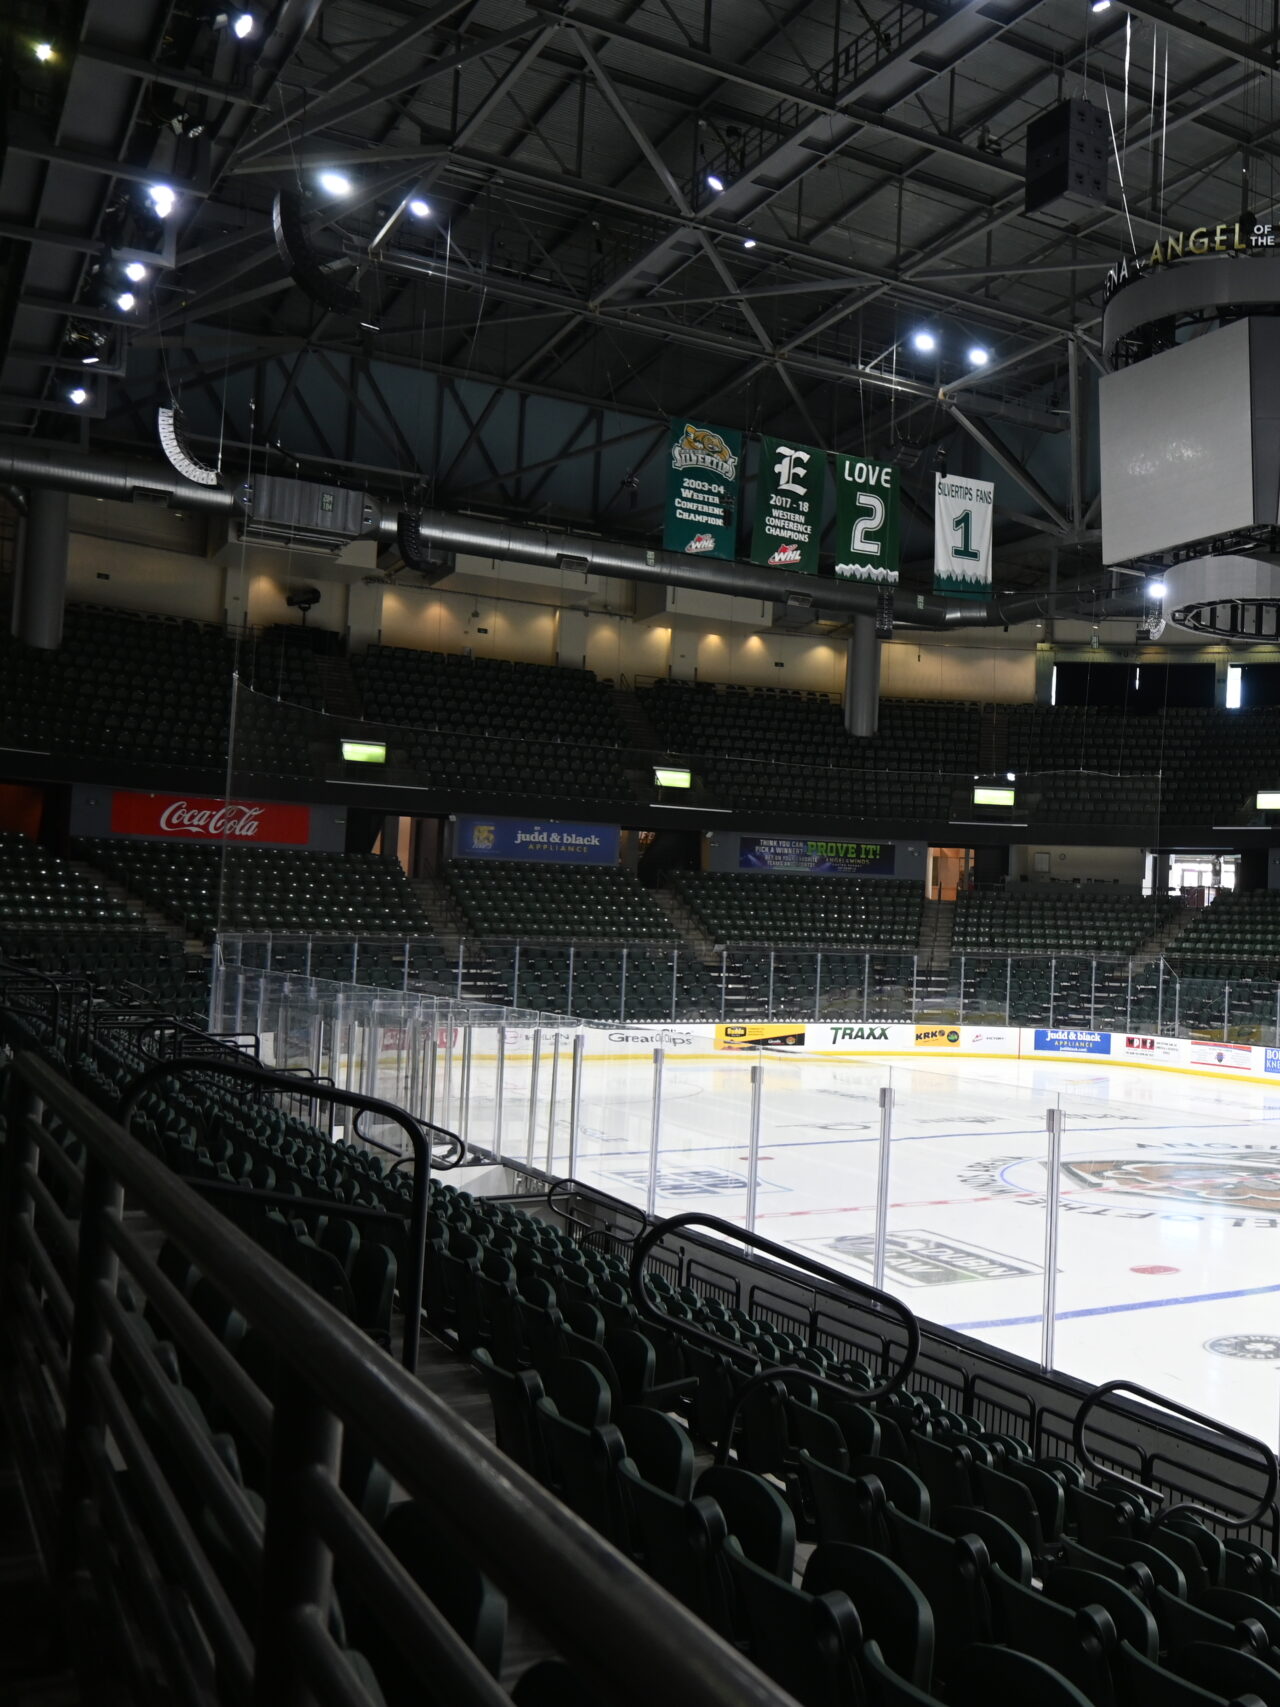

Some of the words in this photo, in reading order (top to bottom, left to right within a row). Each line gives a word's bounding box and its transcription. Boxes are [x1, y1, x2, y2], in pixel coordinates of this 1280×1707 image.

[1253, 224, 1272, 235] OF
[1150, 223, 1246, 267] ANGEL
[1250, 236, 1275, 246] THE
[673, 446, 737, 478] SILVERTIPS
[774, 446, 811, 496] E
[844, 461, 892, 488] LOVE
[683, 478, 725, 494] 2003-04
[937, 482, 973, 501] SILVERTIPS
[975, 489, 992, 505] FANS
[681, 488, 720, 504] WESTER
[770, 494, 792, 509] 2017
[799, 501, 809, 513] 18
[675, 498, 725, 516] CONFERENC
[772, 509, 805, 523] WESTERN
[676, 509, 725, 527] CHAMPION
[765, 517, 812, 534] CONFERENCE
[850, 492, 885, 556] 2
[765, 526, 809, 542] CHAMPIONS
[951, 509, 980, 561] 1
[774, 549, 802, 562] WHL
[160, 801, 265, 836] Coca-Cola
[515, 830, 547, 843] judd
[550, 832, 560, 843] &
[563, 833, 600, 846] black
[528, 843, 588, 853] APPLIANCE
[807, 841, 857, 858] PROVE
[860, 844, 881, 859] IT!
[608, 1032, 654, 1043] Great
[830, 1026, 893, 1044] TRAXX
[1055, 1040, 1093, 1048] APPLIANCE
[1068, 1032, 1076, 1041] &
[1078, 1031, 1101, 1042] black
[865, 1252, 943, 1273] LAW
[925, 1248, 1021, 1278] DUBIN
